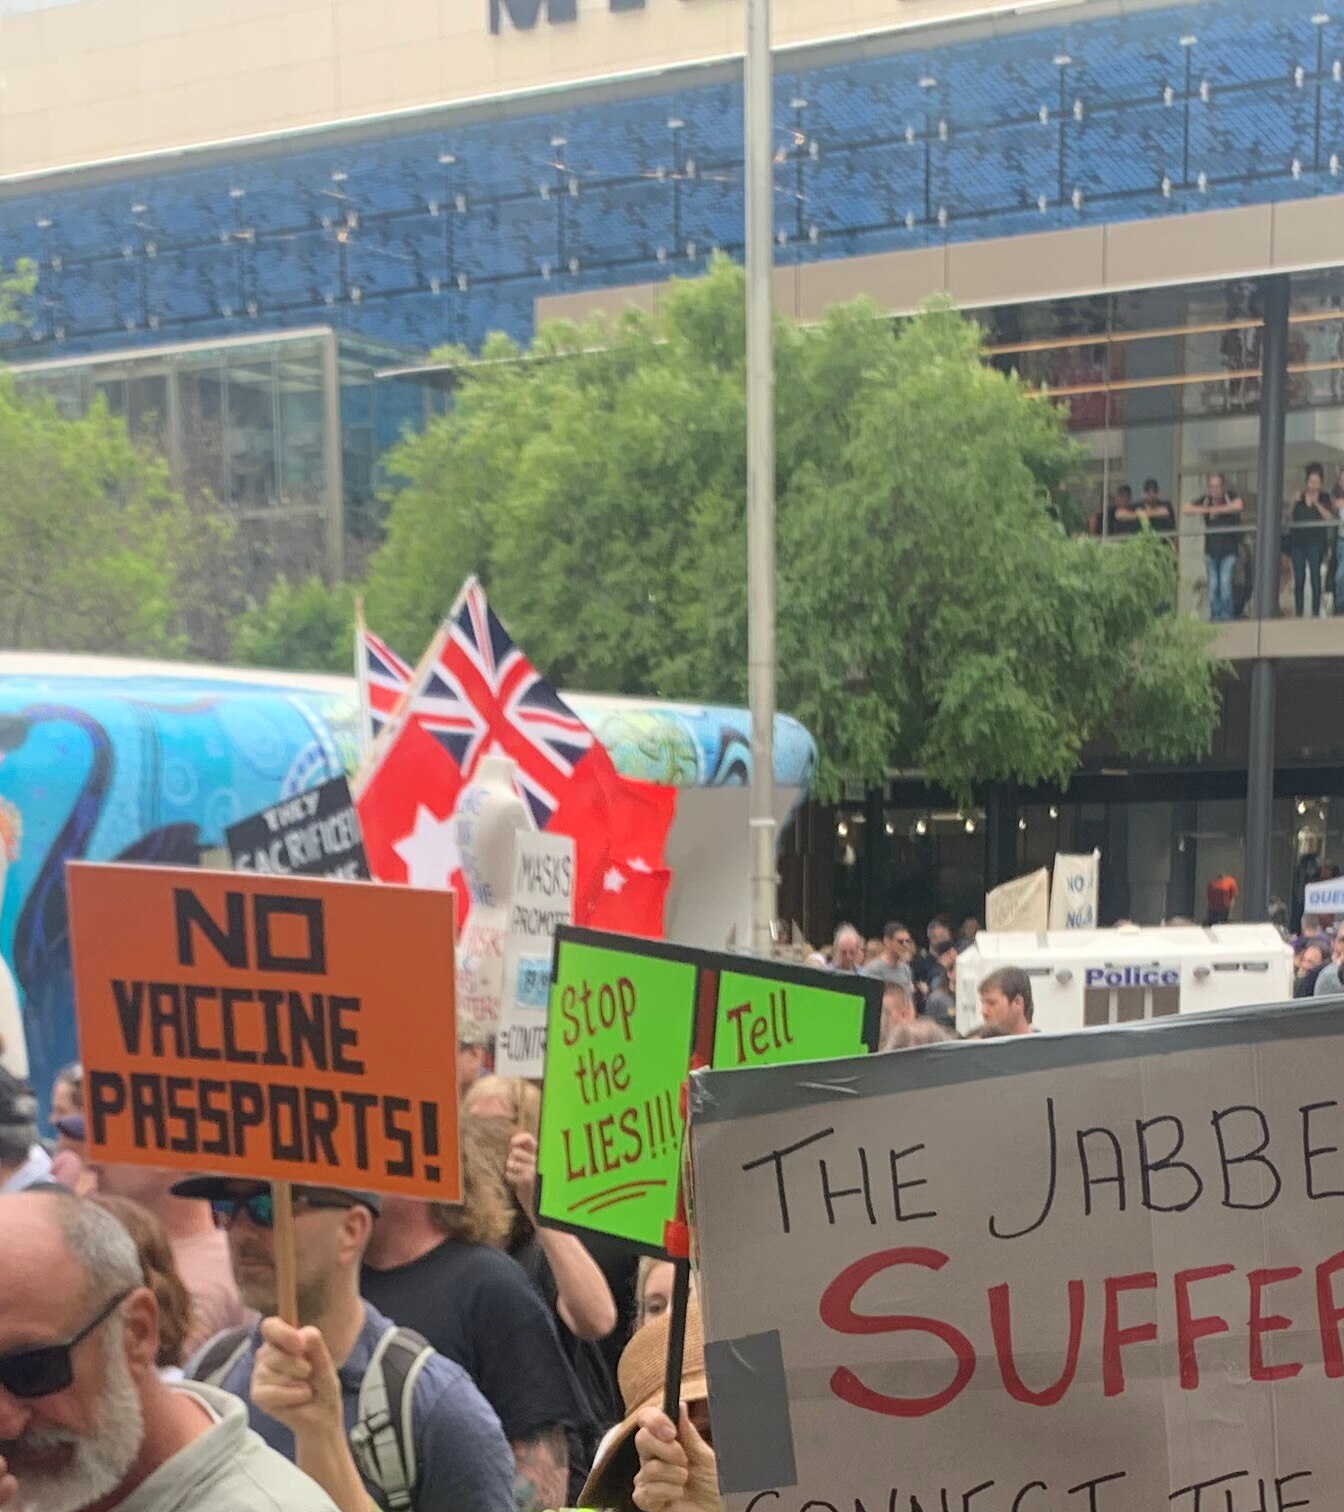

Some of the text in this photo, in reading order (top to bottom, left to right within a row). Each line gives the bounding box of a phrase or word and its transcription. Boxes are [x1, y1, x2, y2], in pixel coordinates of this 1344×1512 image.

[519, 853, 572, 898] MASKS
[173, 888, 327, 976] NO
[560, 976, 637, 1046] Stop
[1086, 967, 1179, 987] Police
[112, 978, 366, 1077] VACCINE
[726, 988, 794, 1064] Tell
[575, 1048, 631, 1105] the
[88, 1071, 443, 1183] PASSPORTS!
[561, 1089, 678, 1183] LIES!!!
[741, 1127, 937, 1232] THE
